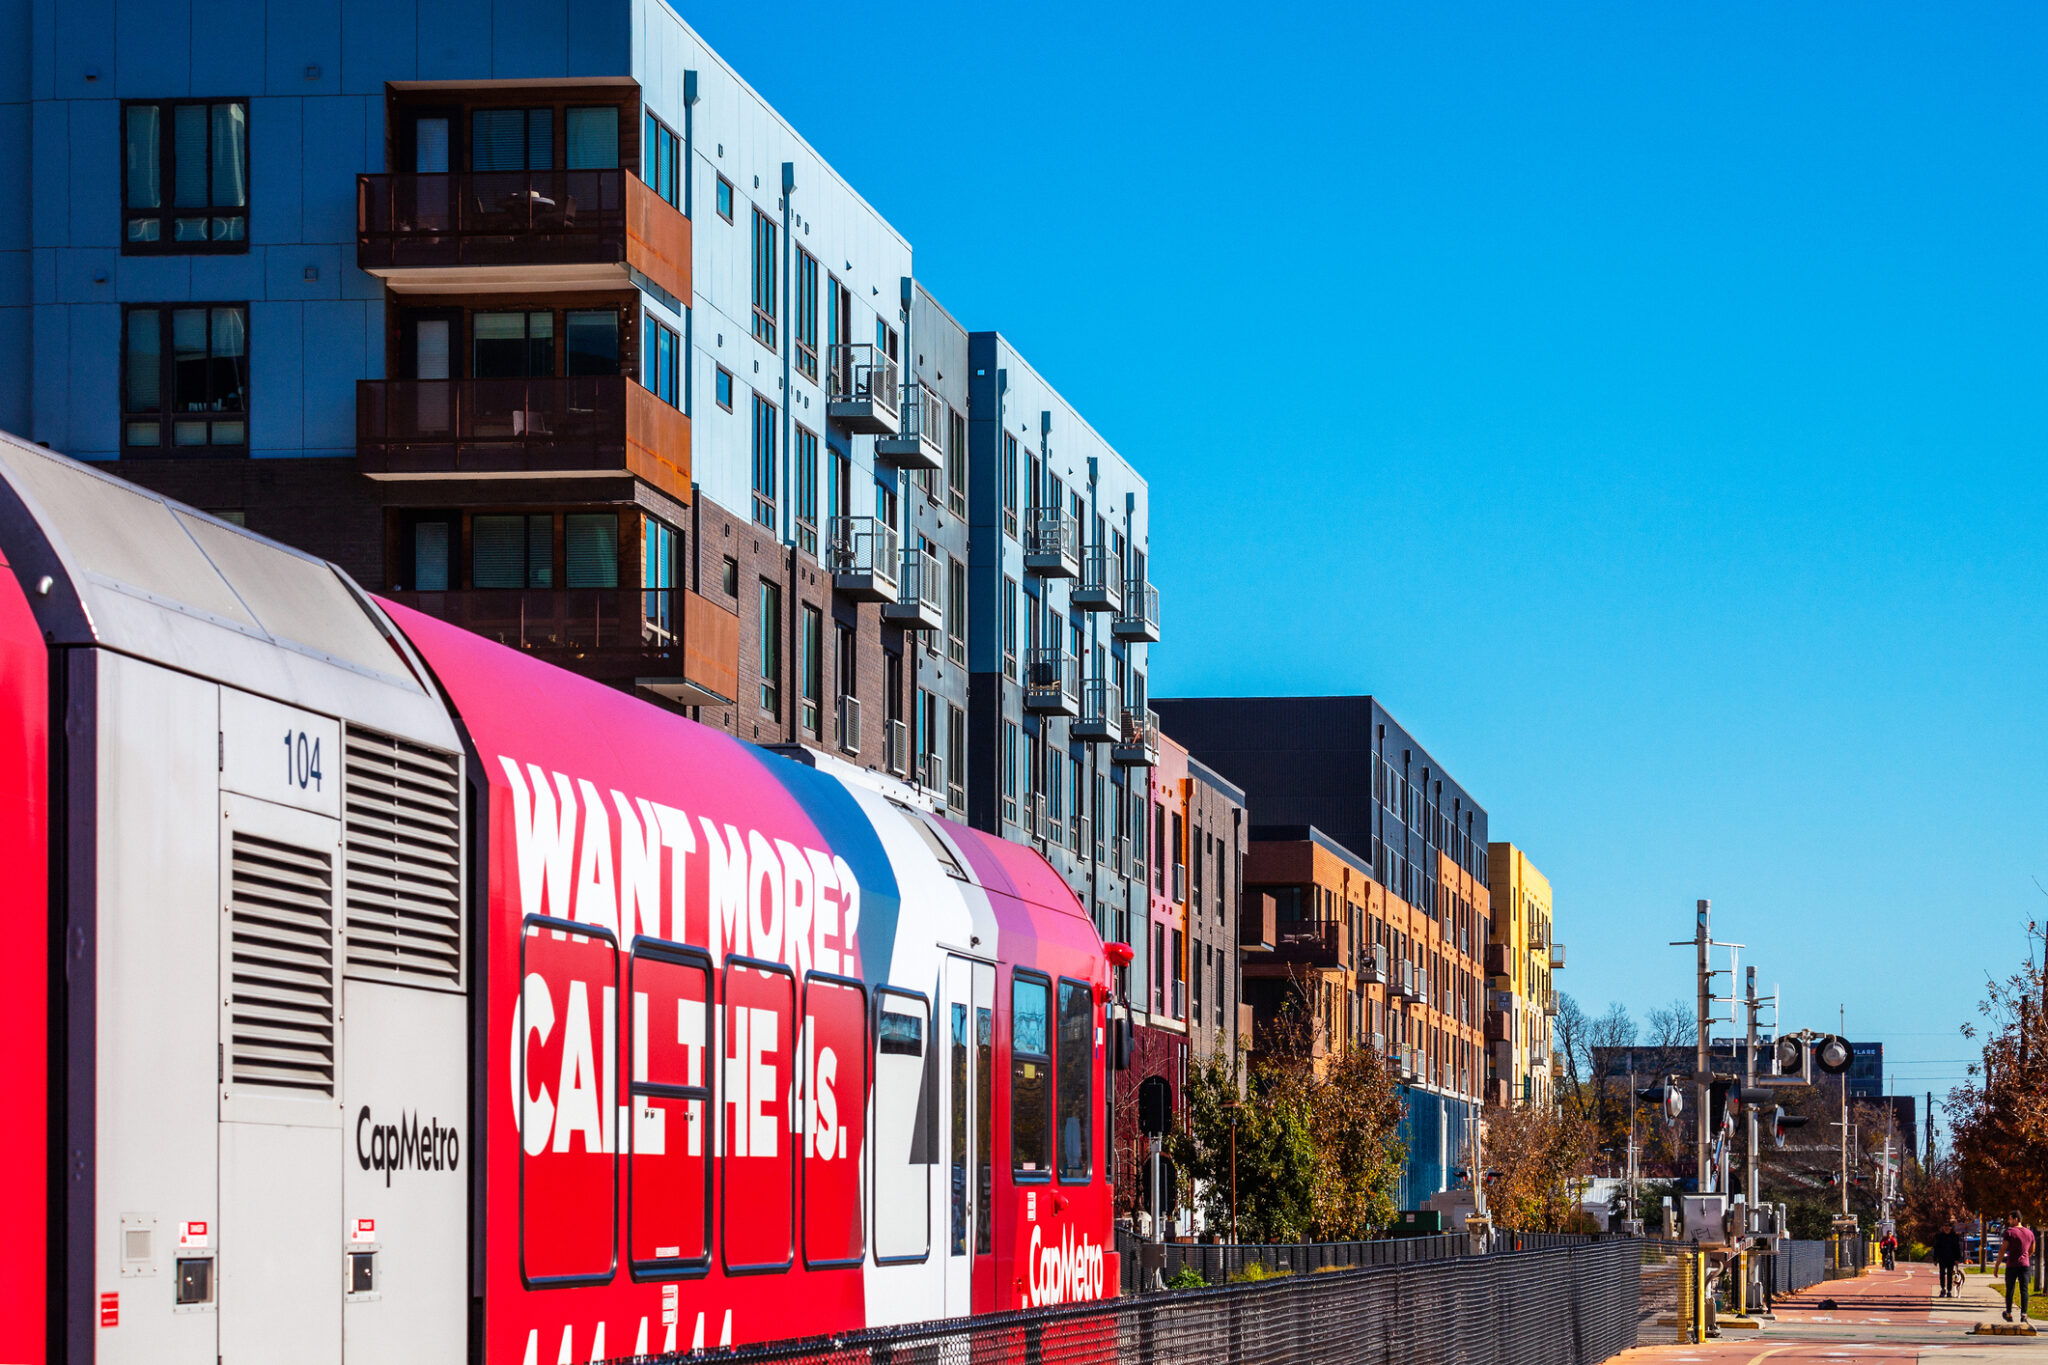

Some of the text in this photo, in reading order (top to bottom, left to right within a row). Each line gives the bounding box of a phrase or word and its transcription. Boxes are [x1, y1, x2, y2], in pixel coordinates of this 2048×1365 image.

[284, 729, 322, 792] 104
[498, 755, 860, 989] WANT MORE?
[511, 973, 665, 1156] CALL
[678, 998, 778, 1158] THE
[357, 1105, 459, 1188] CapMetro
[1029, 1222, 1104, 1307] CapMetro
